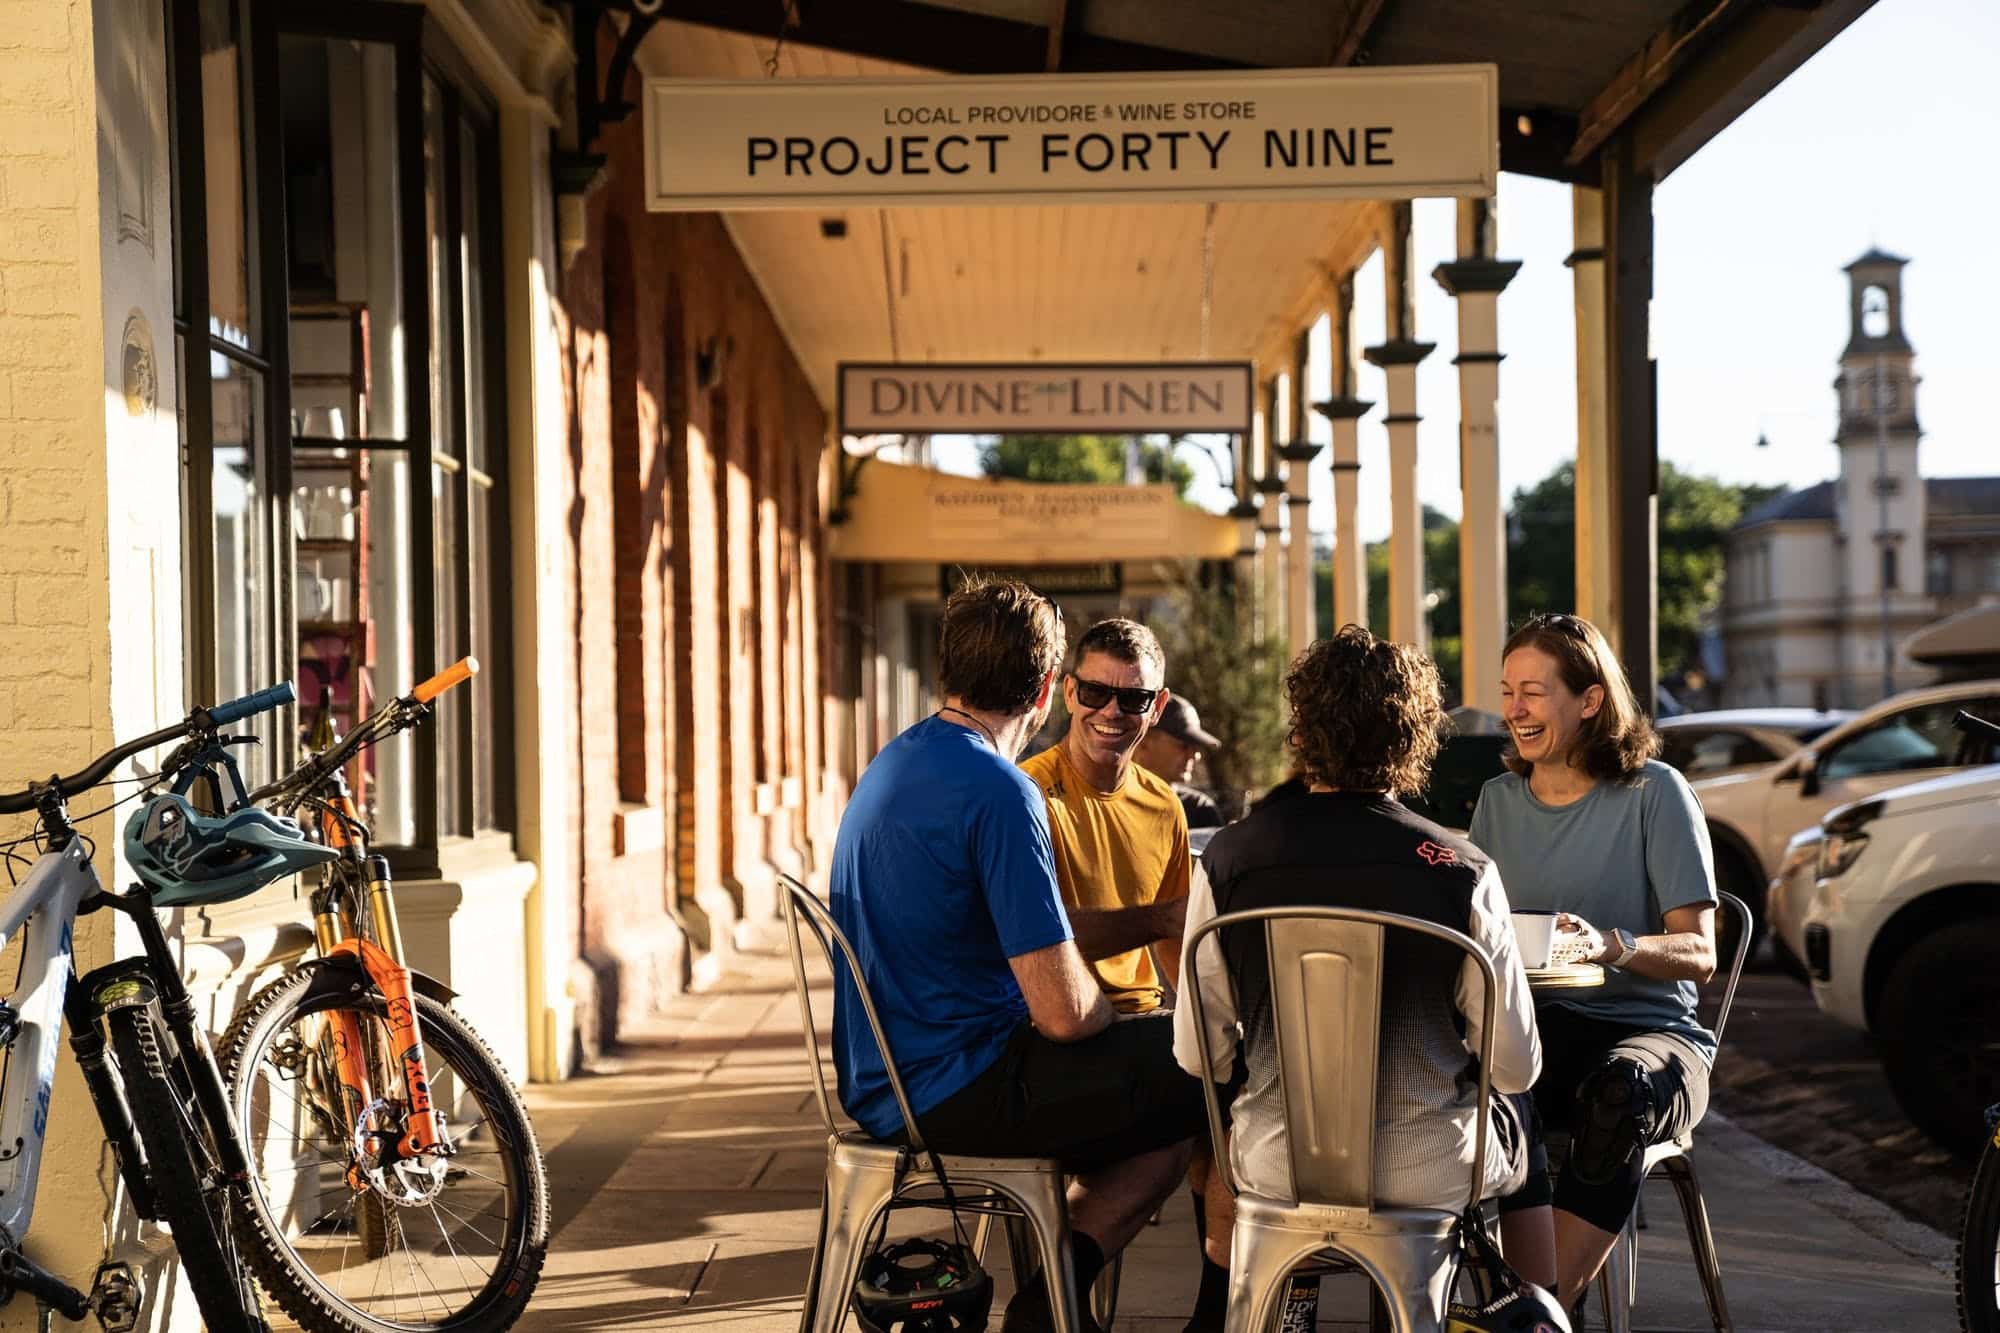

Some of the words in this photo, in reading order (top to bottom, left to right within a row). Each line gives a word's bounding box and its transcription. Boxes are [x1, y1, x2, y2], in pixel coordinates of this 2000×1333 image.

[884, 106, 961, 125] LOCAL
[968, 104, 1097, 123] PROVIDORE
[1119, 103, 1176, 122] WINE
[1183, 101, 1256, 120] STORE
[747, 134, 1009, 176] PROJECT
[1041, 130, 1230, 173] FORTY
[1264, 126, 1393, 169] NINE
[870, 376, 1031, 416] DIVINE
[1070, 377, 1224, 416] LINEN
